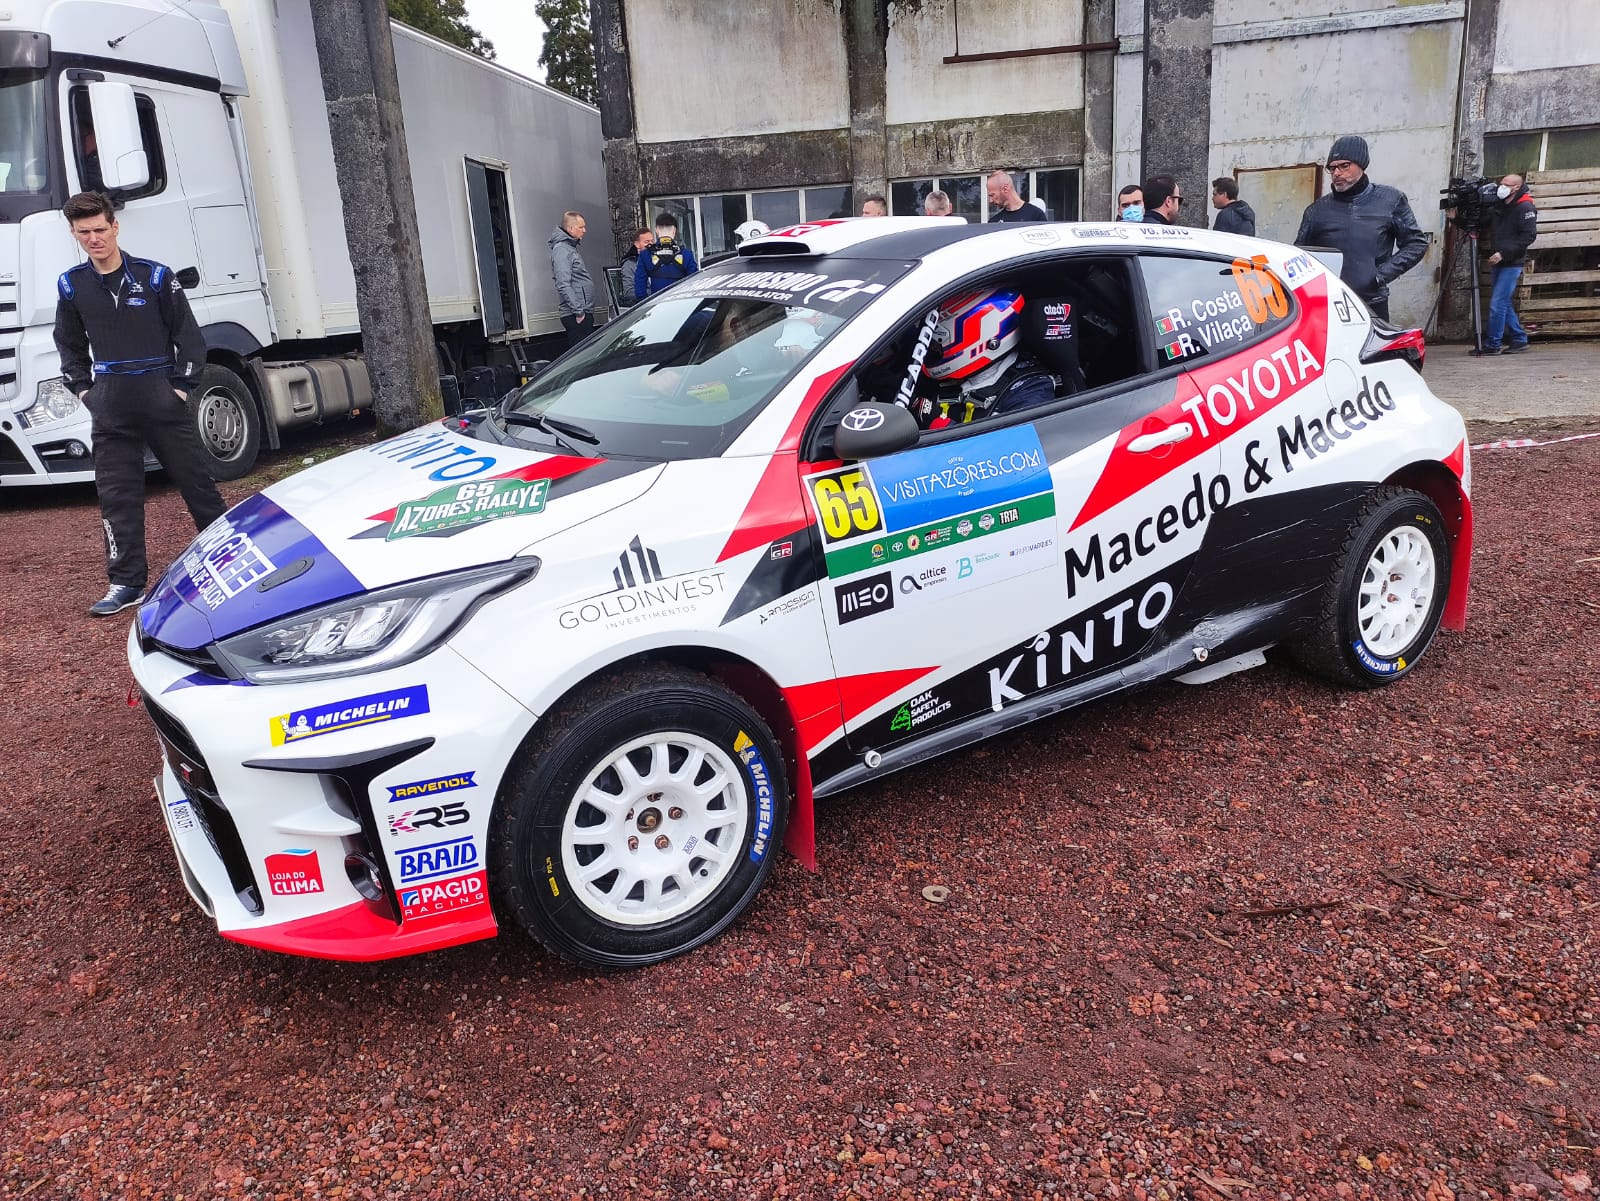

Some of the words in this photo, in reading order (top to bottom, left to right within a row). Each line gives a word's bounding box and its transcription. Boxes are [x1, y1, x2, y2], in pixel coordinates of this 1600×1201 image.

[717, 272, 829, 292] TURISMO
[731, 290, 793, 300] SIMULATOR
[1232, 254, 1288, 324] 65
[1168, 308, 1192, 332] R.
[1191, 290, 1244, 322] Costa
[1178, 333, 1201, 357] R.
[1197, 315, 1252, 347] Vilaça
[1180, 339, 1322, 438] TOYOTA
[882, 449, 1041, 503] VISITAZORES.COM
[1064, 472, 1231, 600] Macedo
[1243, 440, 1274, 493] &
[1277, 375, 1396, 474] Macedo
[456, 483, 496, 501] 65
[814, 472, 879, 539] 65
[394, 500, 473, 533] AZORES
[474, 482, 546, 511] RALLYE
[772, 546, 792, 558] GR
[919, 565, 947, 581] altice
[198, 578, 226, 611] CALOR
[559, 572, 725, 629] GOLDINVEST
[842, 583, 889, 613] MEO
[605, 604, 697, 630] INVESTIMENTOS
[1355, 644, 1390, 671] MICHELIN
[314, 696, 411, 728] MICHELIN
[910, 691, 933, 707] OAK
[911, 698, 939, 718] SAFETY
[911, 701, 952, 727] PRODUCTS
[396, 775, 470, 798] RAVENOL
[750, 763, 773, 856] MICHELIN
[400, 842, 477, 877] BRAID
[271, 872, 292, 881] LOJA
[292, 871, 305, 880] DO
[274, 879, 320, 894] CLIMA
[421, 877, 482, 903] PAGID
[405, 892, 484, 916] RACING
